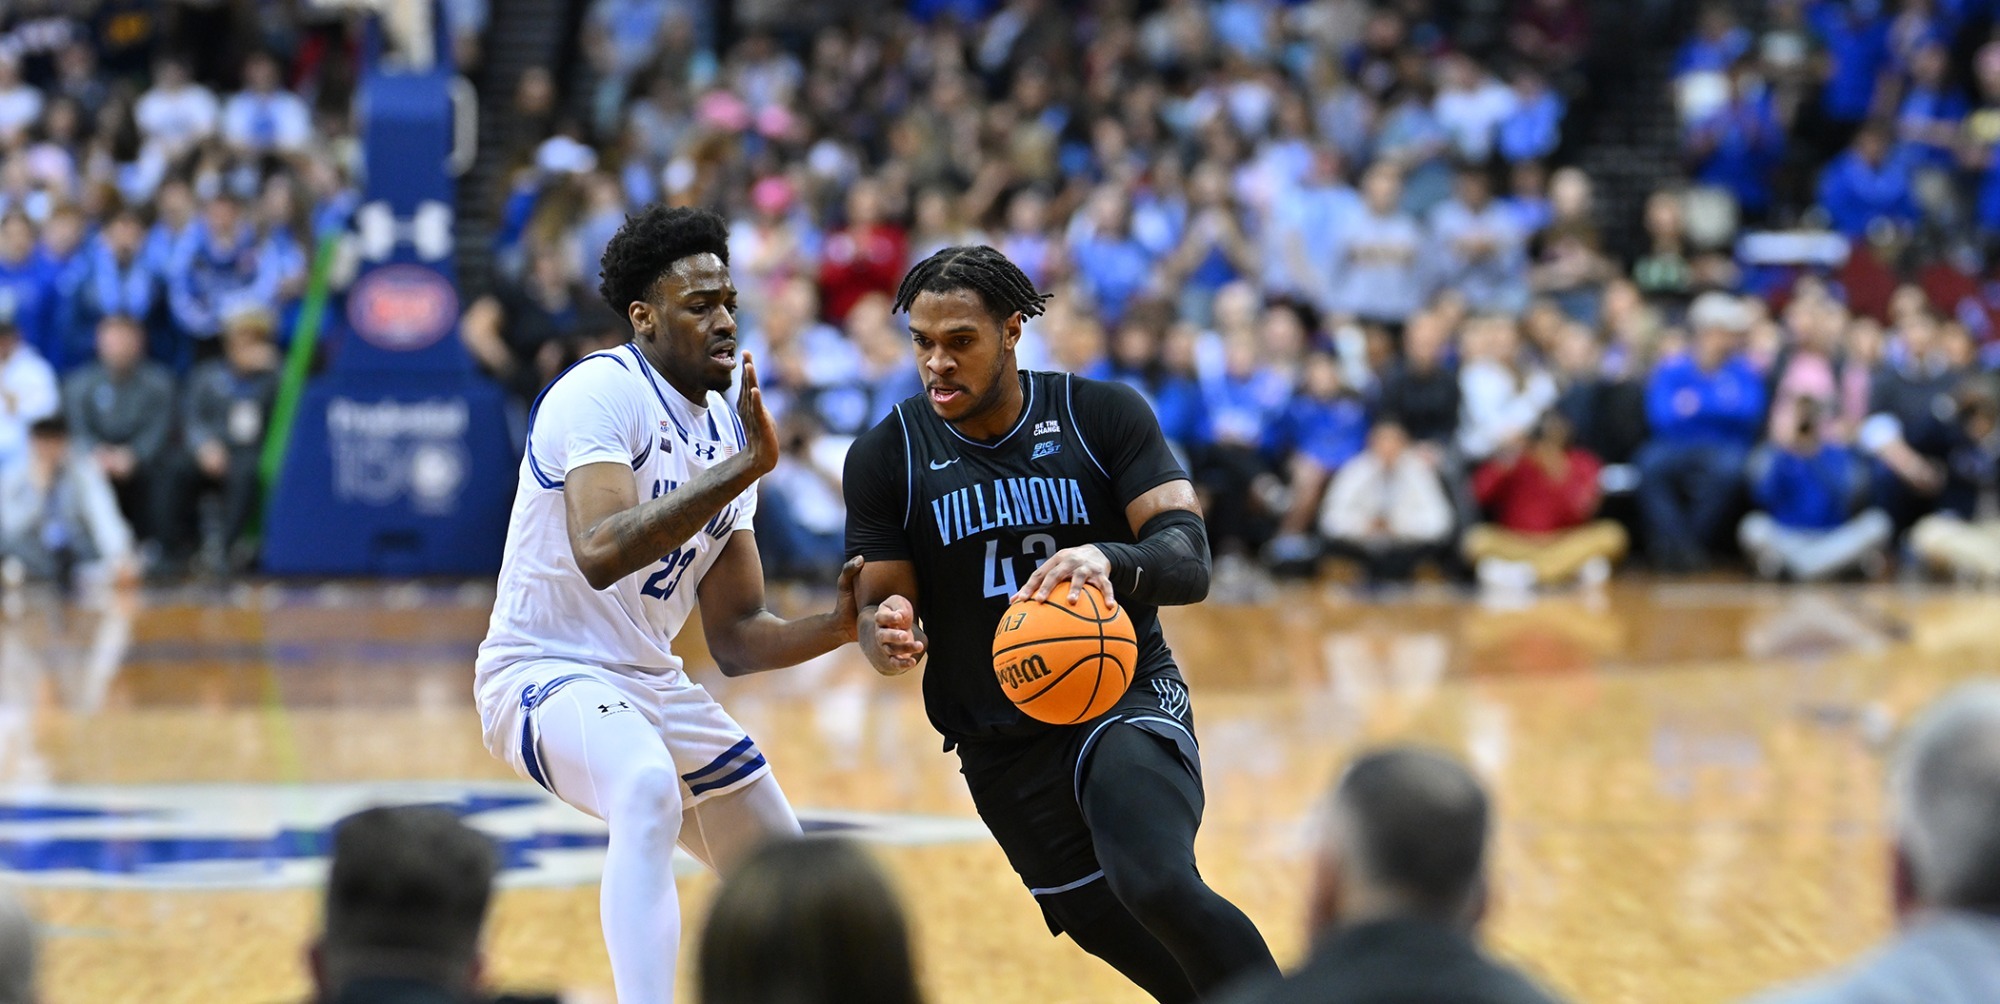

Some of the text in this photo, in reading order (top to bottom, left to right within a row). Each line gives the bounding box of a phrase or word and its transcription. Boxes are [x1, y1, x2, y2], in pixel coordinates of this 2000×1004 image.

[1033, 426, 1061, 436] CHANGE
[1034, 422, 1045, 430] BE
[1034, 440, 1055, 450] BIG
[1031, 445, 1062, 457] EAST
[931, 476, 1090, 547] VILLANOVA
[640, 546, 697, 601] 23
